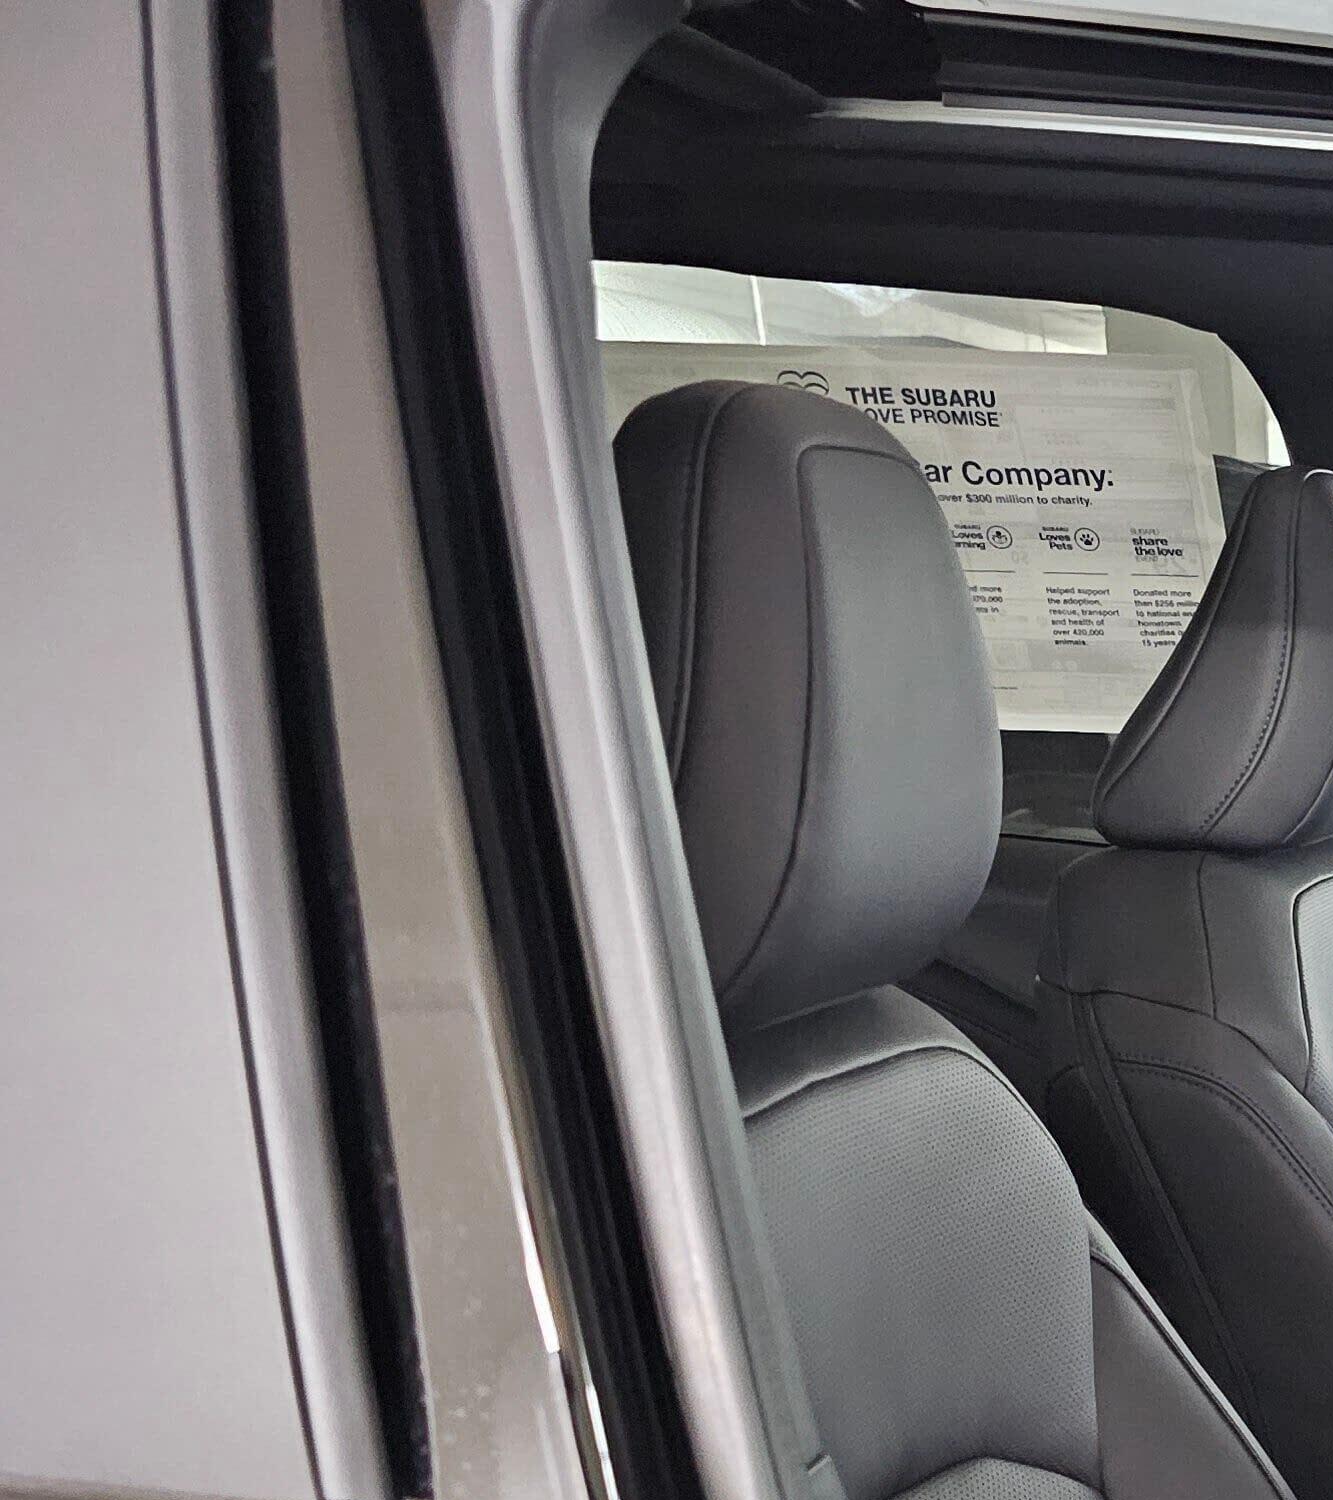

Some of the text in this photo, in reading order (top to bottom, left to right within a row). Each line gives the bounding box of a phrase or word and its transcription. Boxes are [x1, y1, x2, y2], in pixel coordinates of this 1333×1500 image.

[845, 387, 996, 408] THE SUBARU
[864, 408, 905, 424] OVE
[924, 463, 952, 484] ar
[937, 494, 1092, 508] over $300 million to charity.
[951, 530, 984, 539] Loves
[1039, 532, 1071, 542] Loves
[1049, 541, 1073, 550] Pets
[1132, 536, 1168, 546] share
[1134, 546, 1183, 556] the love
[1046, 587, 1110, 596] Helped support
[1133, 589, 1168, 597] Donated
[1062, 598, 1102, 607] adoption,
[1049, 609, 1120, 618] rescue, transport
[1182, 610, 1194, 618] an
[1068, 618, 1094, 626] health
[1096, 619, 1105, 627] of
[1140, 629, 1175, 637] charities
